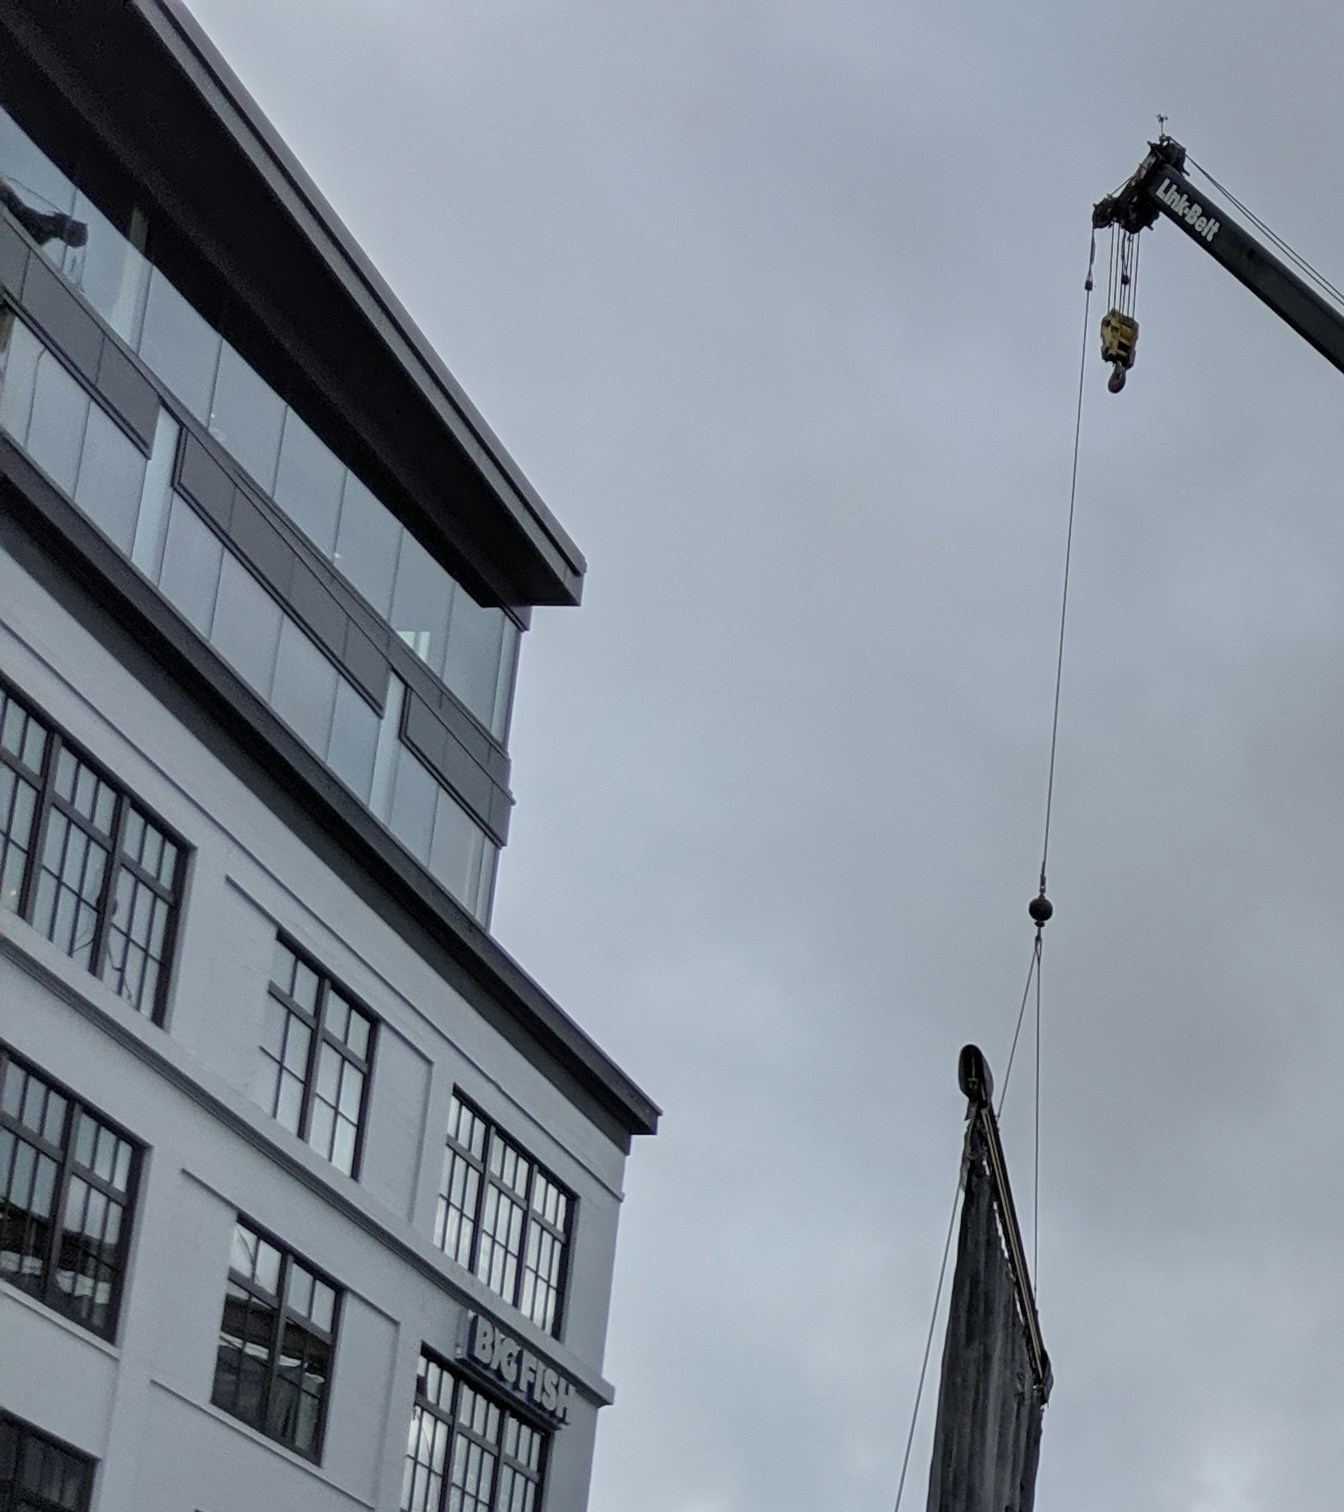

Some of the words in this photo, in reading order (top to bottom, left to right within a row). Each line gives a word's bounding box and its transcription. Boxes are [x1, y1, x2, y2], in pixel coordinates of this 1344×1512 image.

[1156, 178, 1220, 241] Link-Belt
[474, 1315, 521, 1383] BIG
[519, 1349, 575, 1419] FISH
